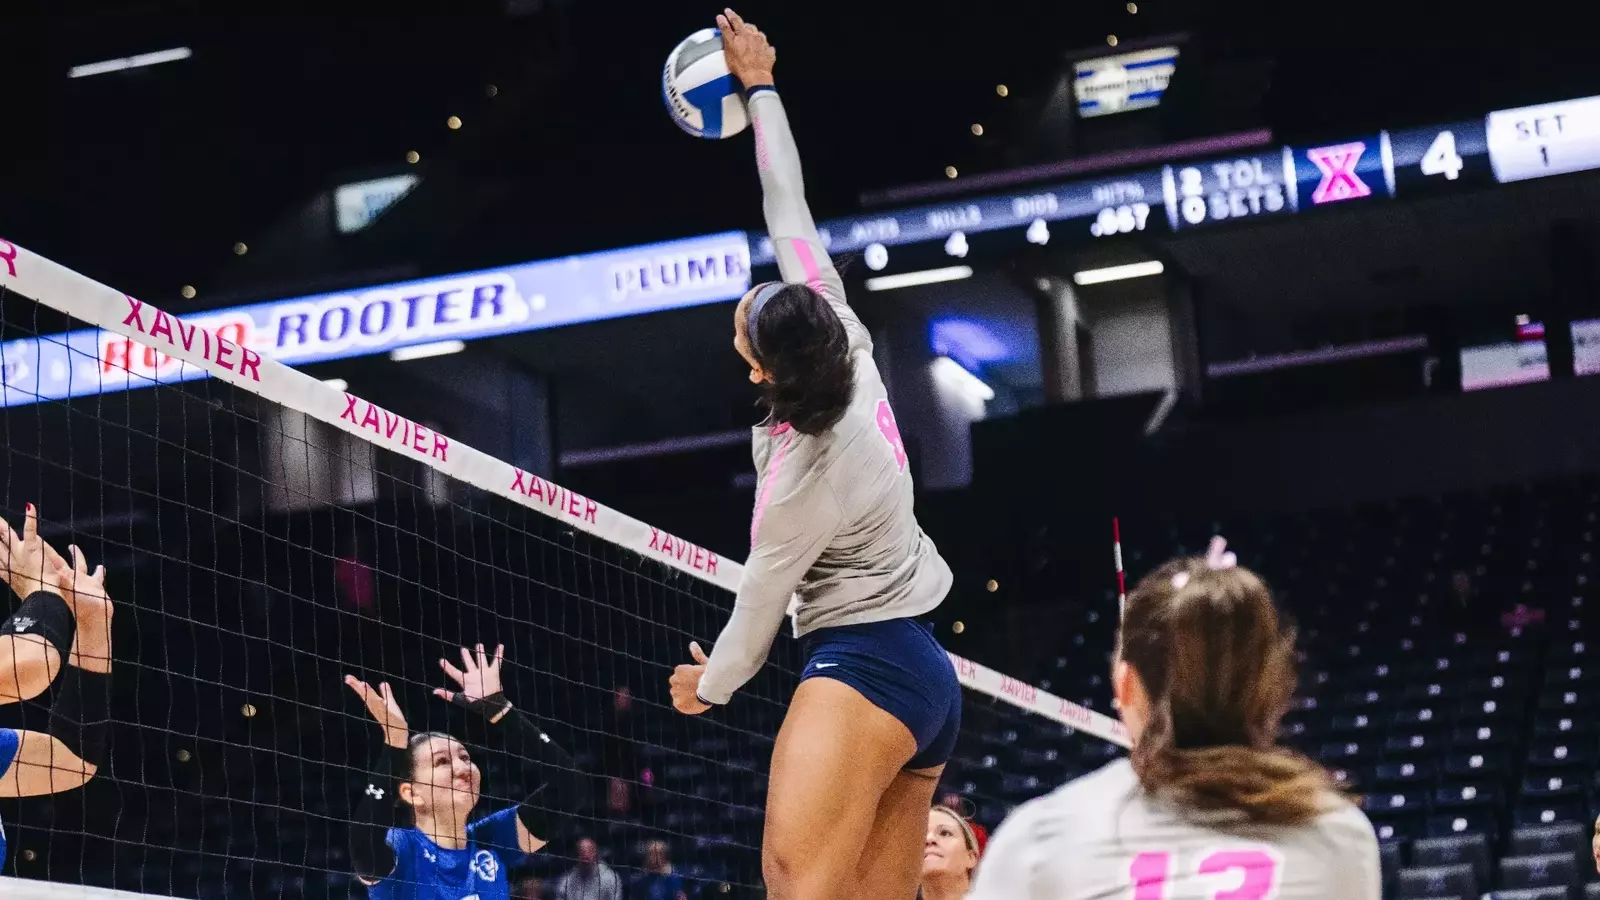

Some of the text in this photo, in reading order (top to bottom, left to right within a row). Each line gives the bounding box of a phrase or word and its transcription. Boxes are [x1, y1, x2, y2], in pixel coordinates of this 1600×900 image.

[1515, 114, 1568, 141] SET
[1420, 130, 1463, 180] 4
[1540, 145, 1549, 167] 1
[1212, 158, 1274, 190] TOL
[122, 294, 720, 577] XAVIER XAVIER XAVIER XAVIER
